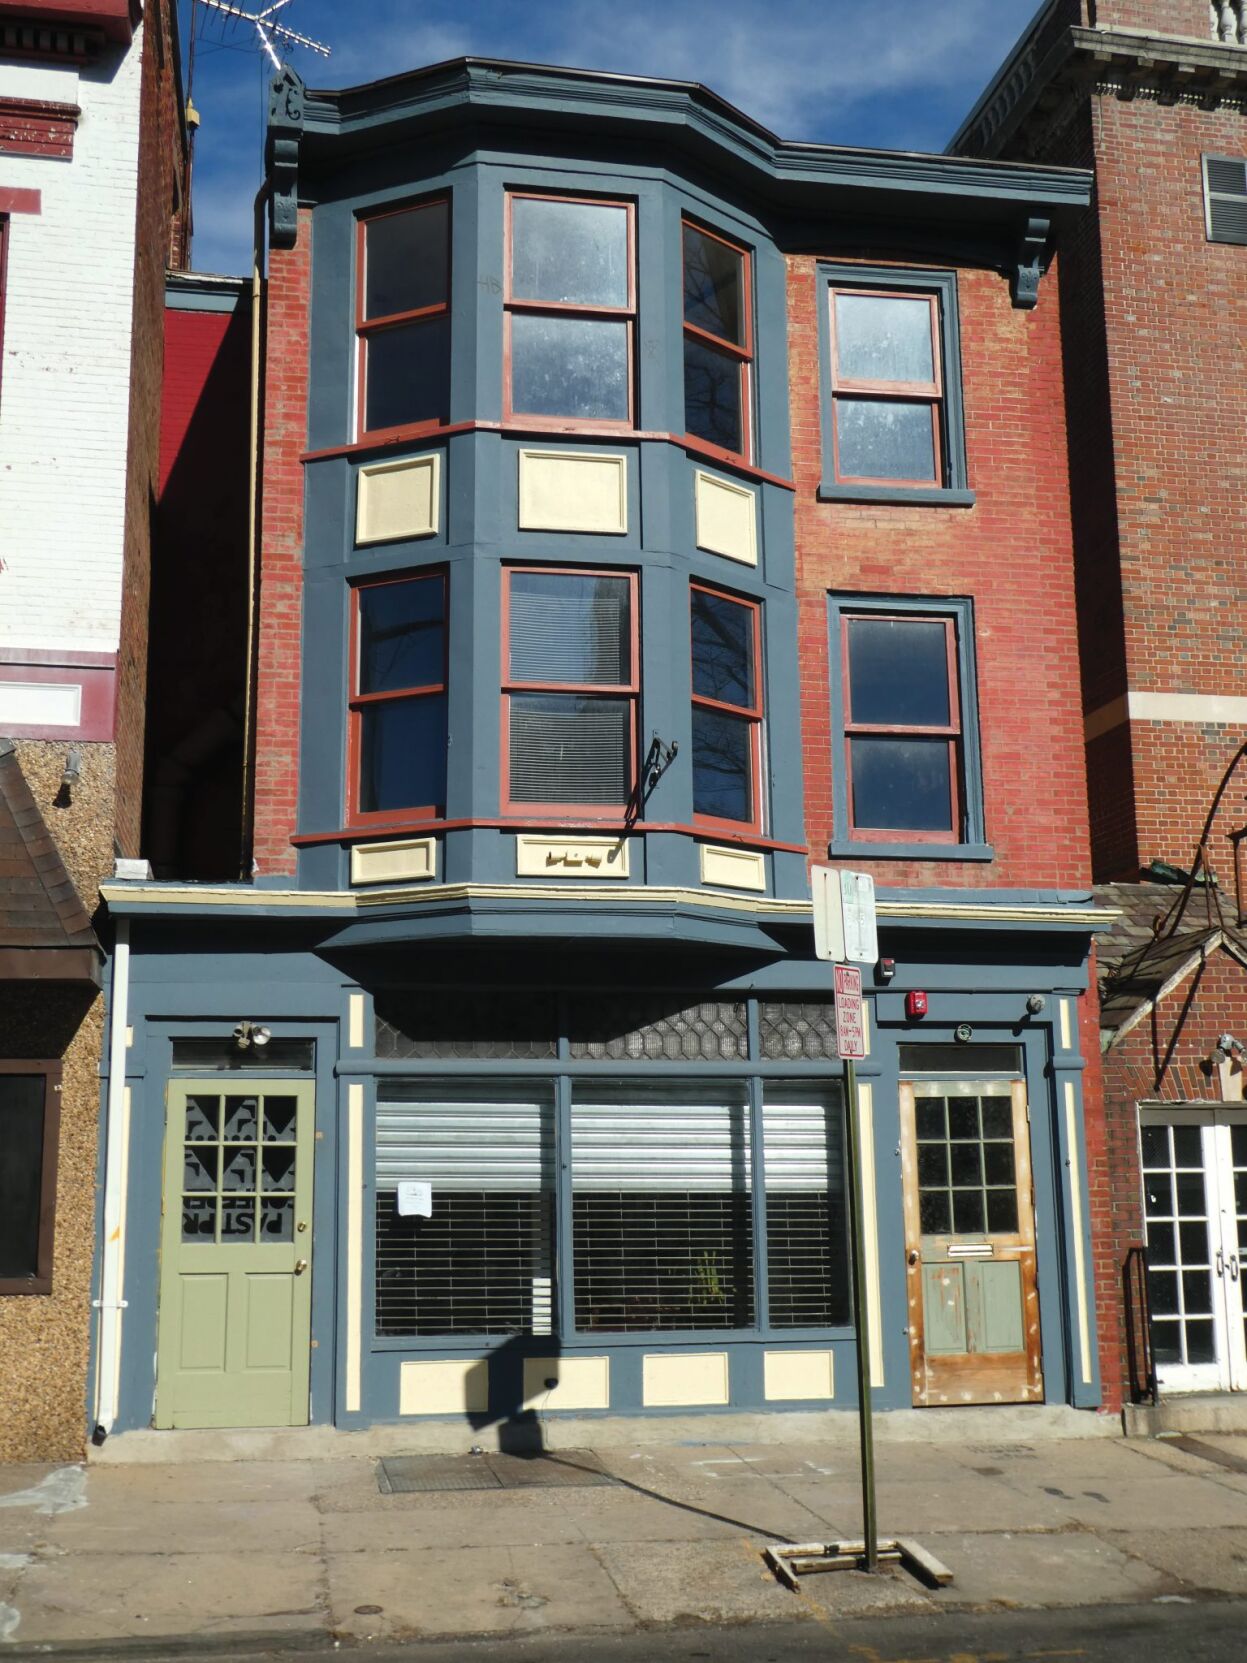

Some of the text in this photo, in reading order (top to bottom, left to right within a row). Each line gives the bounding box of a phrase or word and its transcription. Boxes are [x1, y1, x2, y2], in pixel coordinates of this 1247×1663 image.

[837, 969, 859, 993] NO PARKING
[839, 998, 860, 1011] LOADING
[843, 1011, 857, 1024] ZONE
[844, 1039, 858, 1052] DAILY
